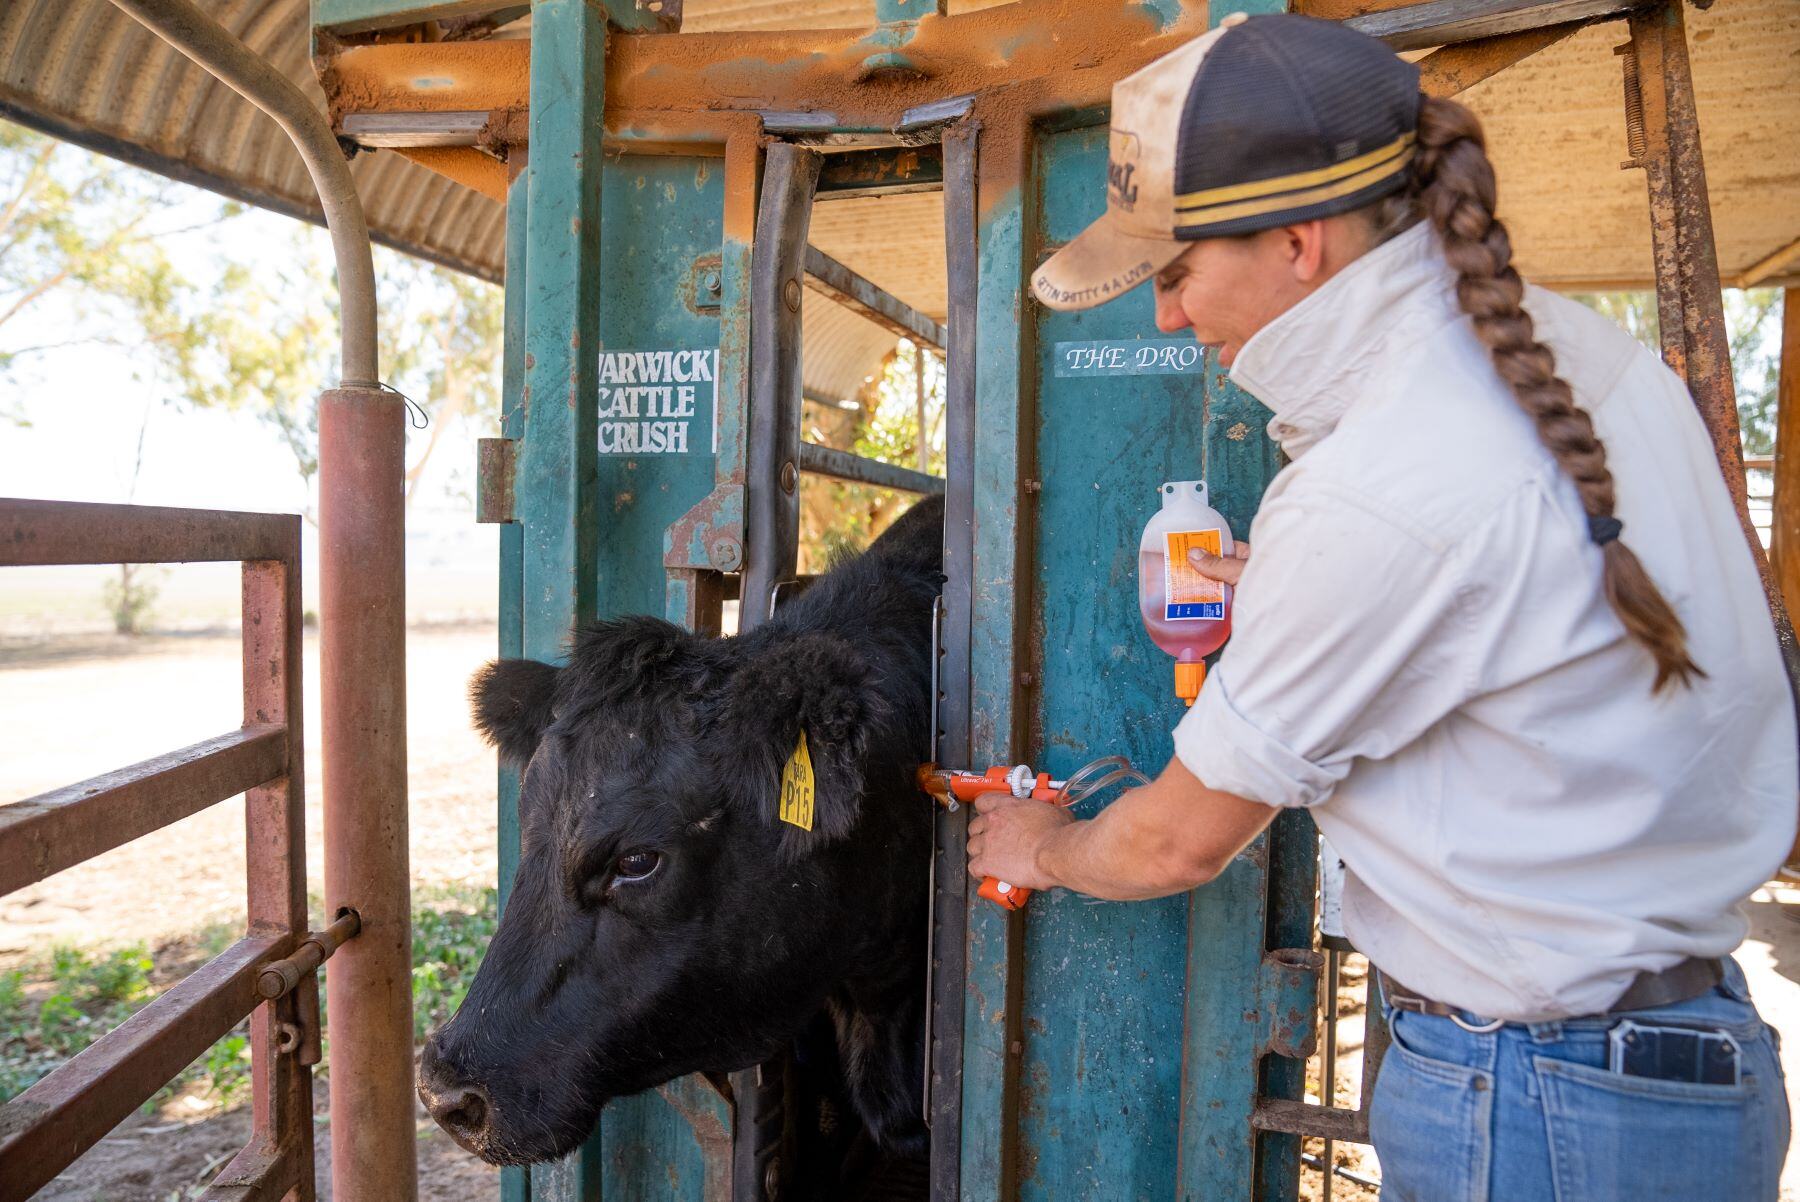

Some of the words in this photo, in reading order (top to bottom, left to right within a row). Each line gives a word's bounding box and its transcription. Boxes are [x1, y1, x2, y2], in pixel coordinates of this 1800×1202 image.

[1102, 282, 1110, 293] 4
[1112, 278, 1122, 290] A
[1066, 345, 1126, 369] THE
[598, 386, 695, 418] CATTLE
[598, 421, 689, 453] CRUSH
[785, 779, 810, 827] P15
